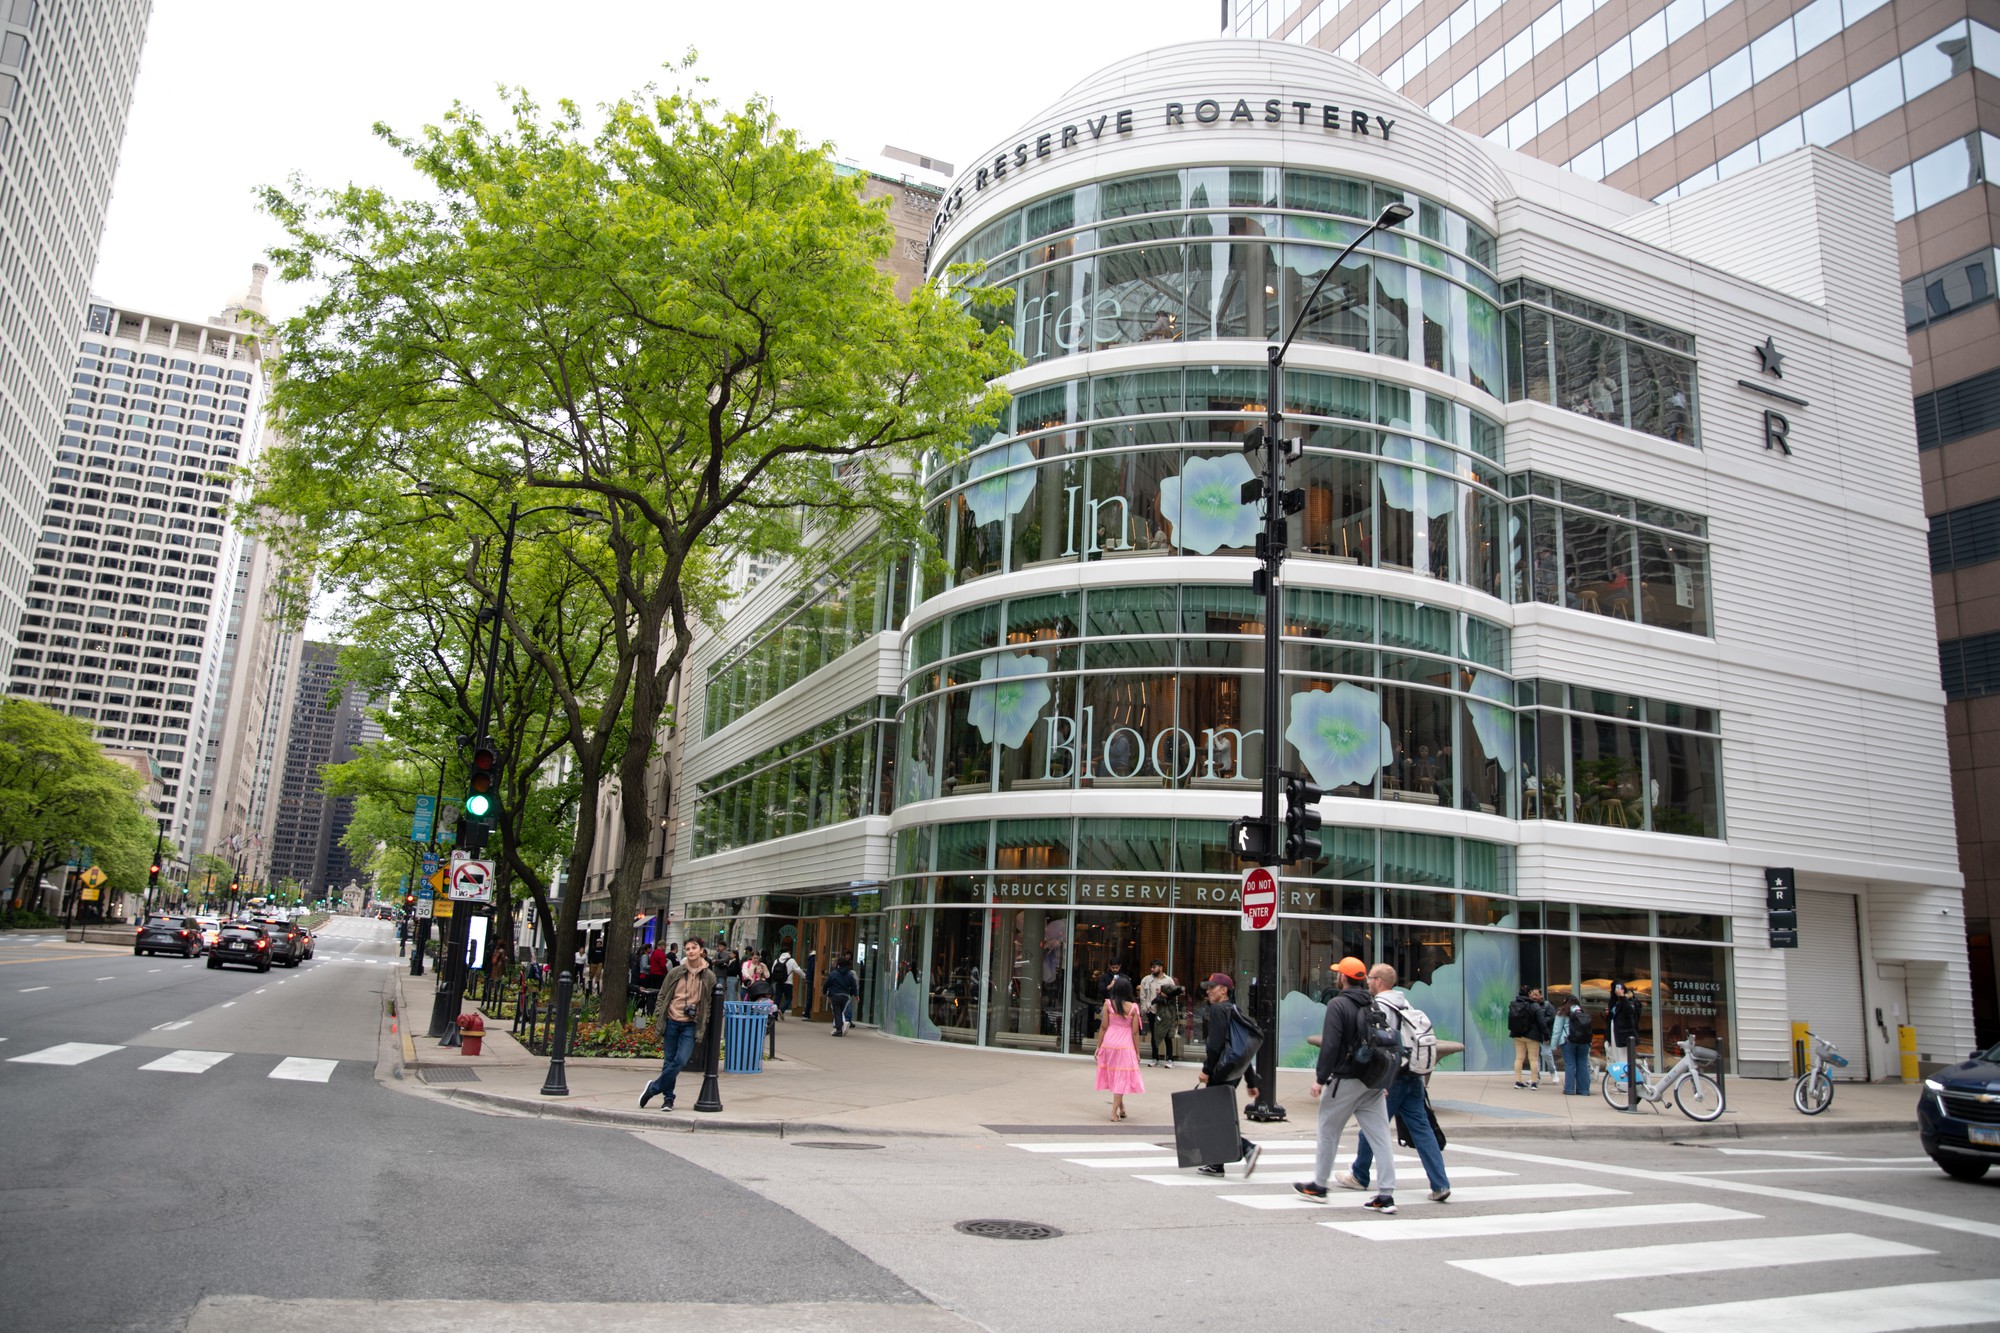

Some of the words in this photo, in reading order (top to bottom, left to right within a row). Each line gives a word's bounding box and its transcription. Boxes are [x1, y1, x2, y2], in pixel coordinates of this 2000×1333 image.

[975, 109, 1134, 191] RESERVE
[1165, 98, 1396, 141] ROASTERY
[1010, 291, 1122, 358] ffee
[1764, 409, 1792, 455] R
[1060, 485, 1136, 557] In
[1040, 705, 1264, 781] Bloom
[424, 865, 435, 873] 90
[1247, 881, 1256, 891] DO
[1259, 879, 1272, 890] NOT
[973, 883, 1068, 896] STARBUCKS
[1081, 884, 1181, 900] RESERVE
[1197, 887, 1316, 906] ROAERY
[1776, 891, 1783, 899] R
[418, 908, 430, 916] 30
[1249, 907, 1269, 918] ENTER
[1673, 981, 1720, 991] STARBUCKS
[1673, 994, 1712, 1003] RESERVE
[1674, 1006, 1717, 1016] ROASTERY
